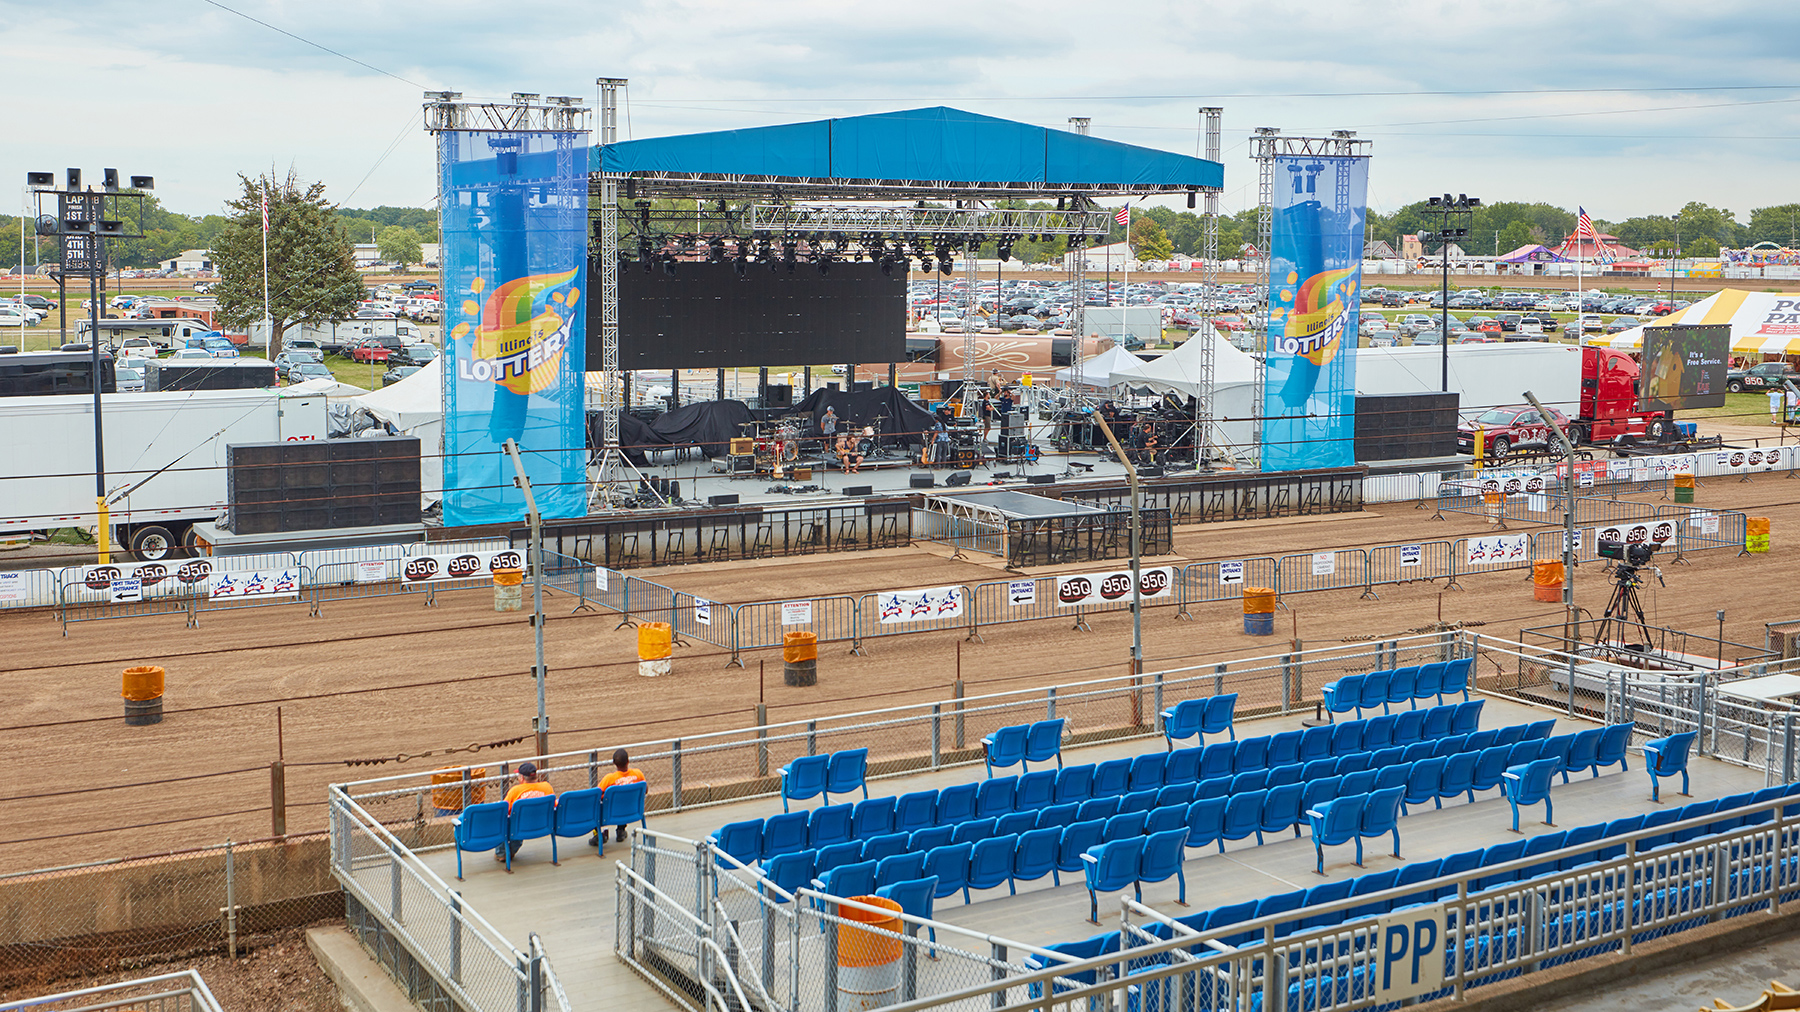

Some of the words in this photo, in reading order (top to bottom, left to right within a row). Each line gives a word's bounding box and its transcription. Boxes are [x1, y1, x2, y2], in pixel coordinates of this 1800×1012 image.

[65, 195, 84, 204] LAP
[66, 211, 83, 221] 1ST
[66, 240, 84, 249] 4TH
[66, 250, 85, 259] 5TH
[1274, 300, 1354, 355] LOTTERY
[1306, 313, 1335, 333] Illinois
[458, 311, 577, 382] LOTTERY
[500, 329, 544, 354] Illinois
[1744, 376, 1764, 386] 95Q
[1599, 531, 1620, 542] 95Q
[1628, 528, 1647, 541] 95Q
[1654, 525, 1672, 538] 95Q
[408, 560, 439, 575] 95Q
[450, 557, 481, 572] 95Q
[491, 554, 521, 569] 95Q
[88, 569, 120, 581] 95Q
[135, 566, 166, 578] 95Q
[180, 562, 212, 577] 95Q
[1061, 580, 1093, 597] 95Q
[1103, 577, 1131, 593] 95Q
[1141, 573, 1168, 589] 95Q
[1010, 587, 1033, 595] ENTRANCE
[1383, 918, 1437, 991] PP
